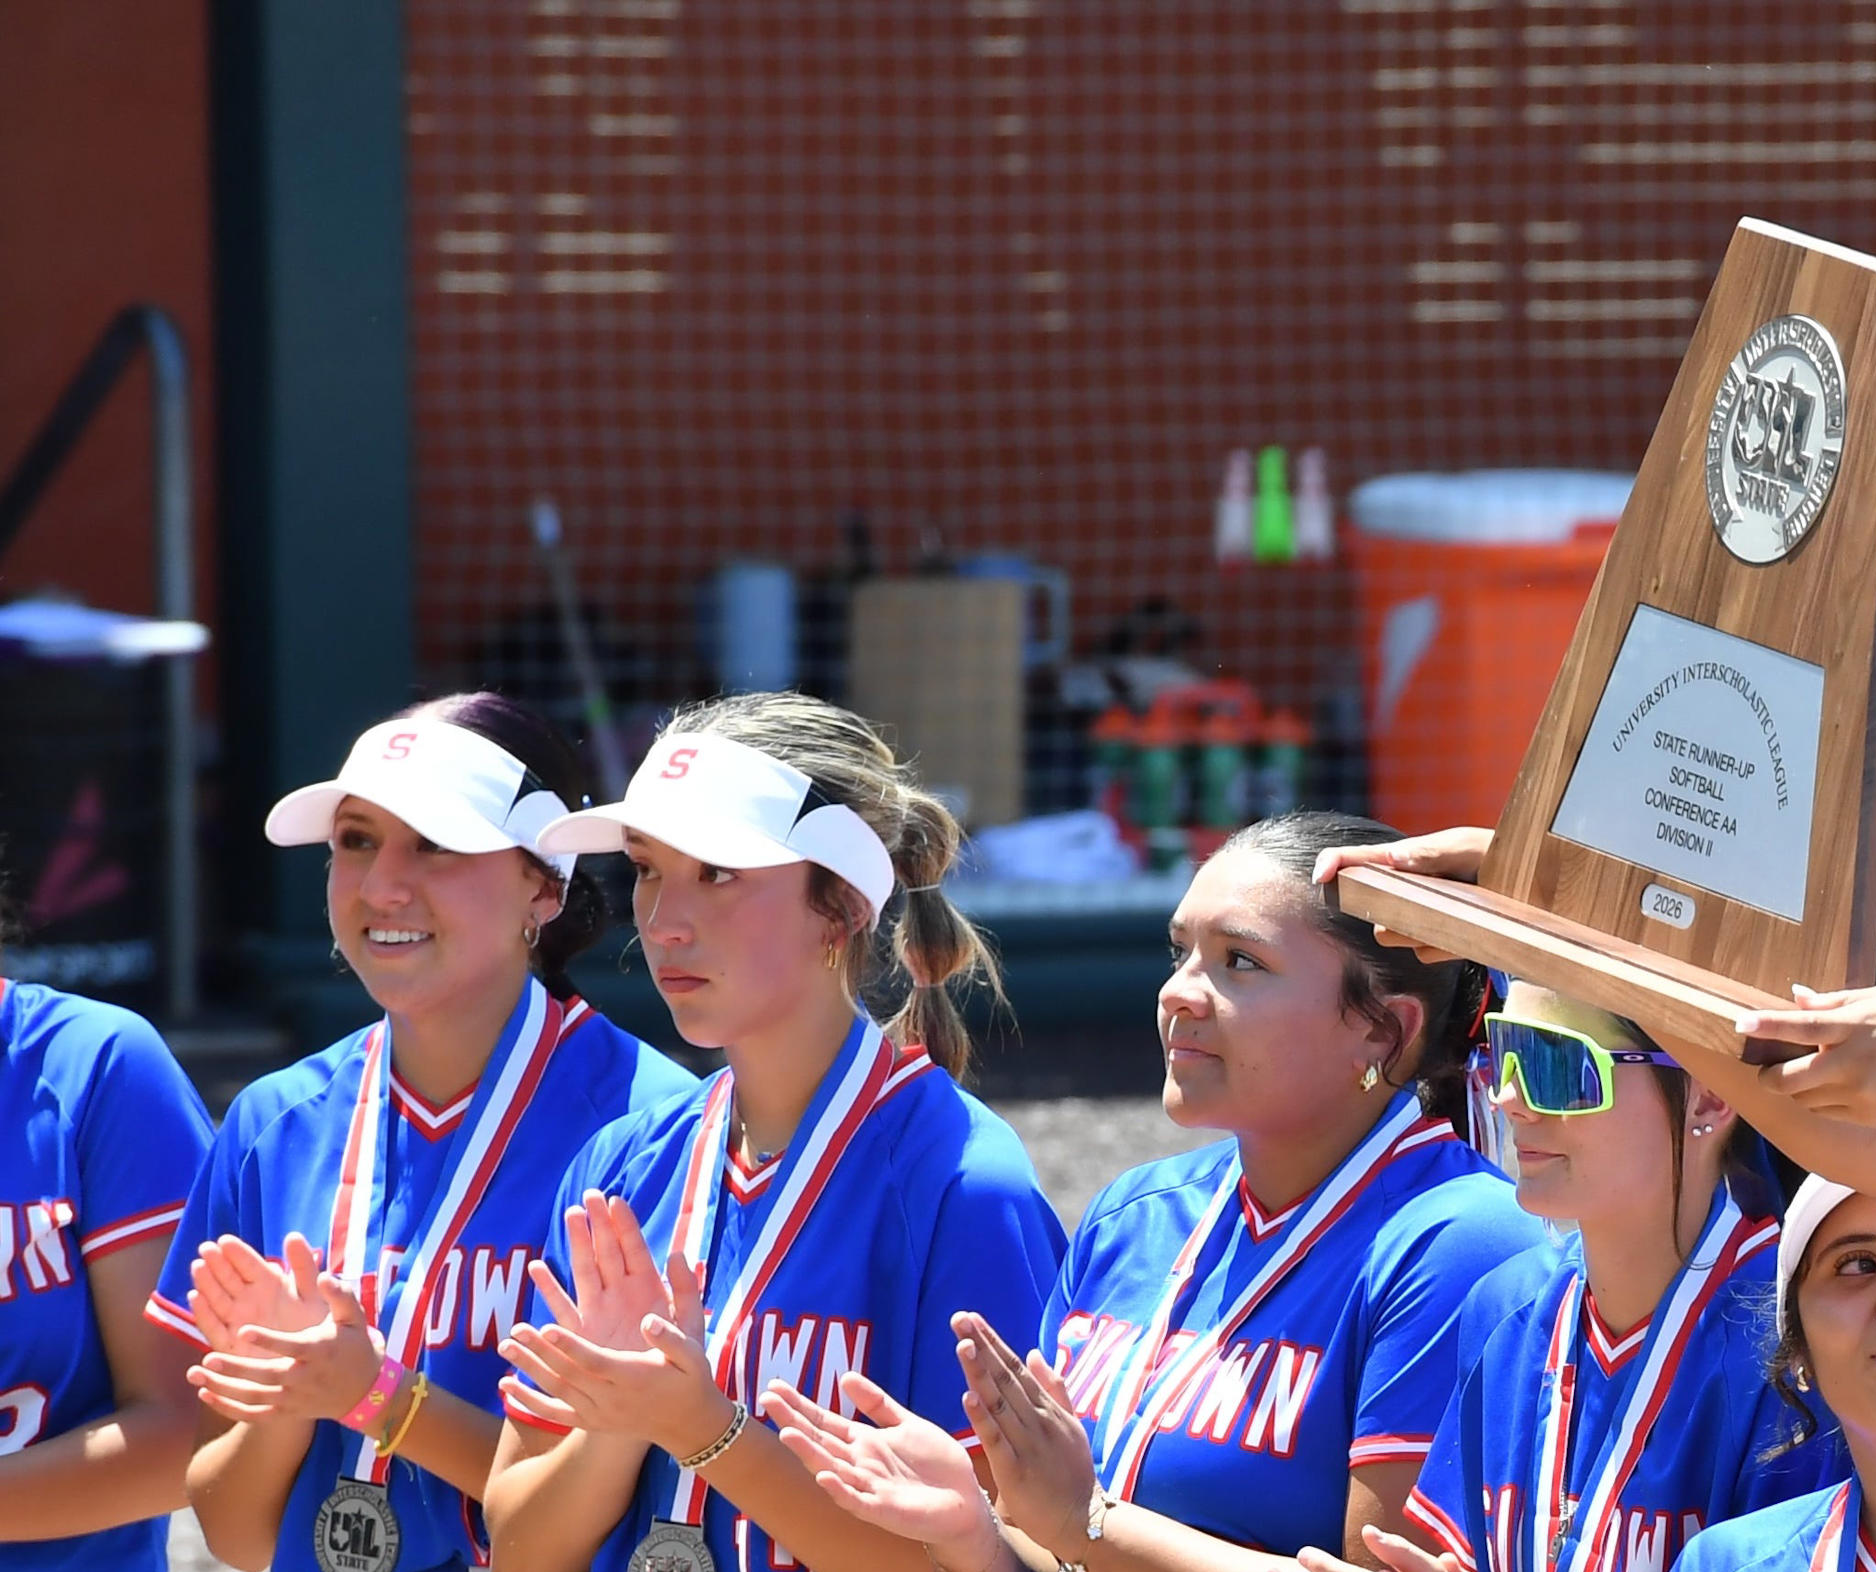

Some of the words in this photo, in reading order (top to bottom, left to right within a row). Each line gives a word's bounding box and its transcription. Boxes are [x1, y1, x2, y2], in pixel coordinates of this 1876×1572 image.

[383, 734, 417, 760] S
[1612, 670, 1680, 752] UNIVERSITY
[1682, 662, 1774, 735] INTERSCHOLASTIC
[1767, 732, 1789, 810] LEAGUE
[660, 749, 699, 779] S
[1653, 731, 1688, 757] STATE
[1688, 743, 1756, 780] RUNNER-UP
[1669, 766, 1726, 801] SOFTBALL
[1644, 787, 1721, 829] CONFERENCE
[1720, 815, 1738, 836] AA
[1656, 822, 1704, 854] DIVISION
[1702, 840, 1714, 857] II
[1653, 893, 1683, 919] 2026
[329, 1510, 380, 1558] UIL
[336, 1555, 369, 1571] STATE
